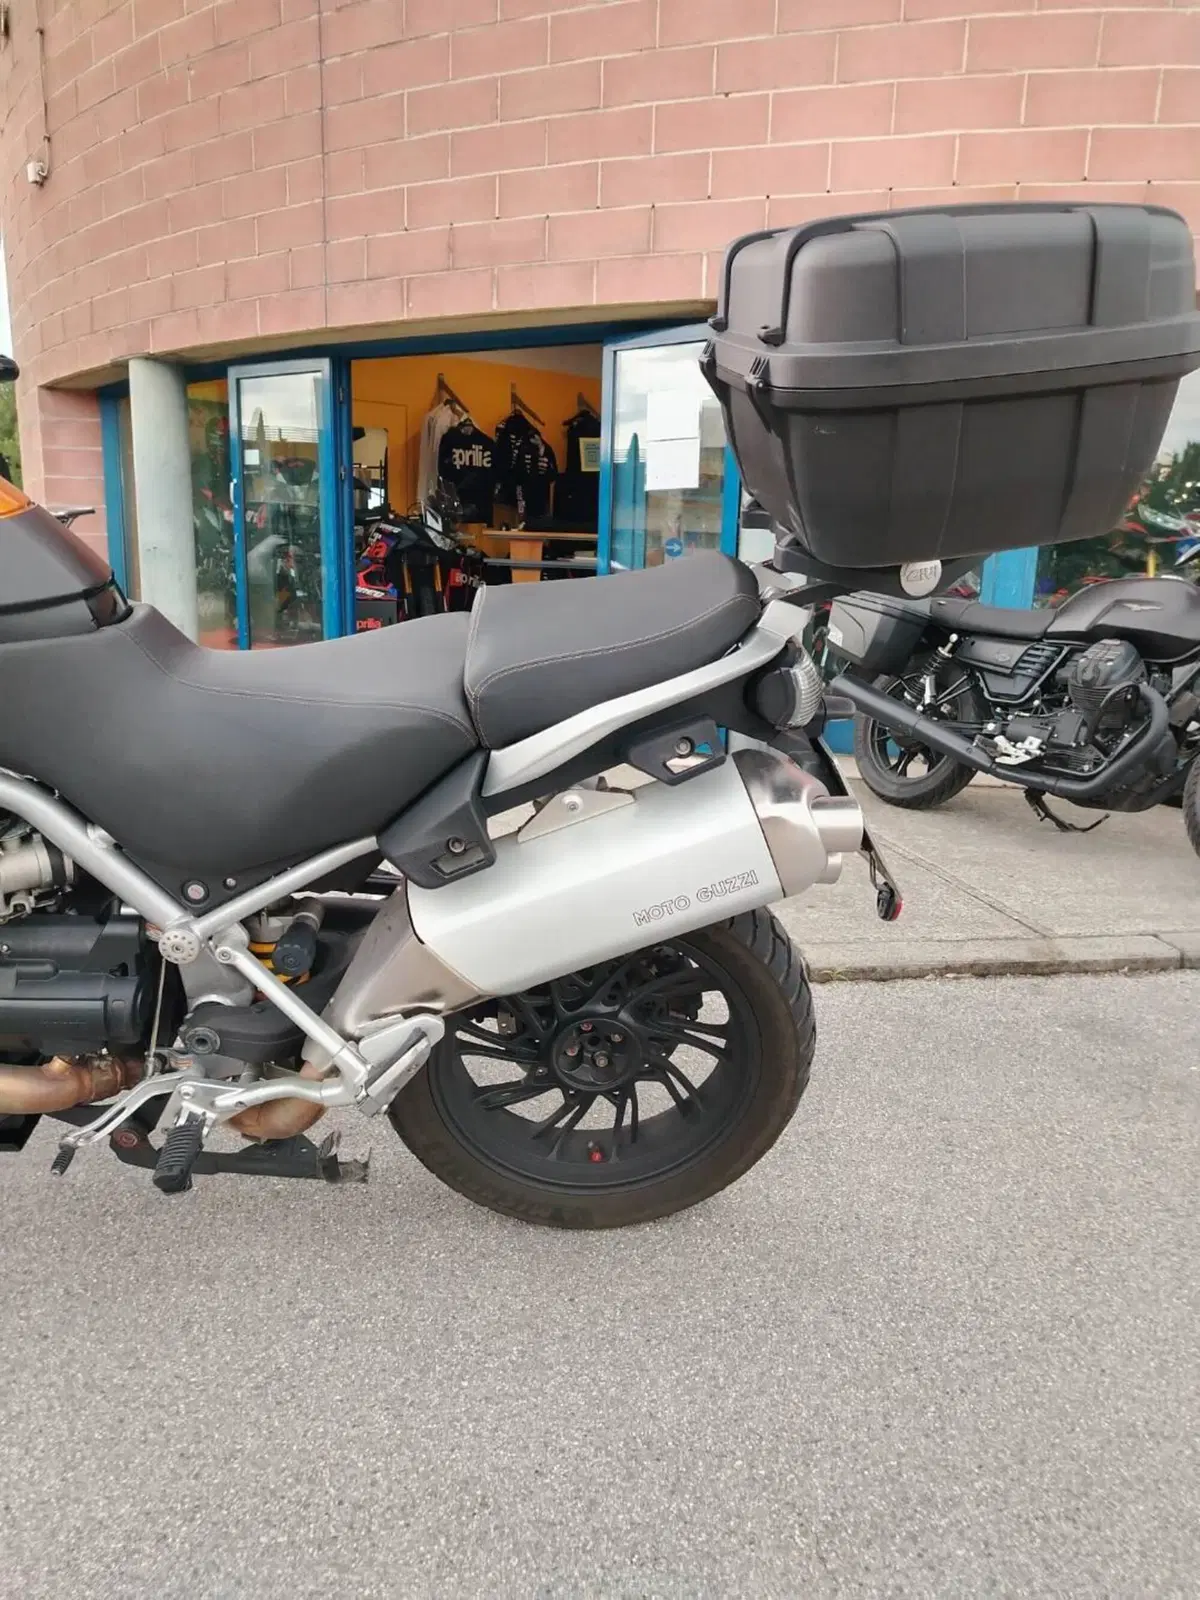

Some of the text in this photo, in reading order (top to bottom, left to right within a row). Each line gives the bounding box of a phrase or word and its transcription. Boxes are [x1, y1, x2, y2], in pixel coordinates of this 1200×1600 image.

[452, 444, 492, 470] aprilia
[356, 617, 381, 630] prilia
[632, 869, 760, 926] MOTO GUZZI
